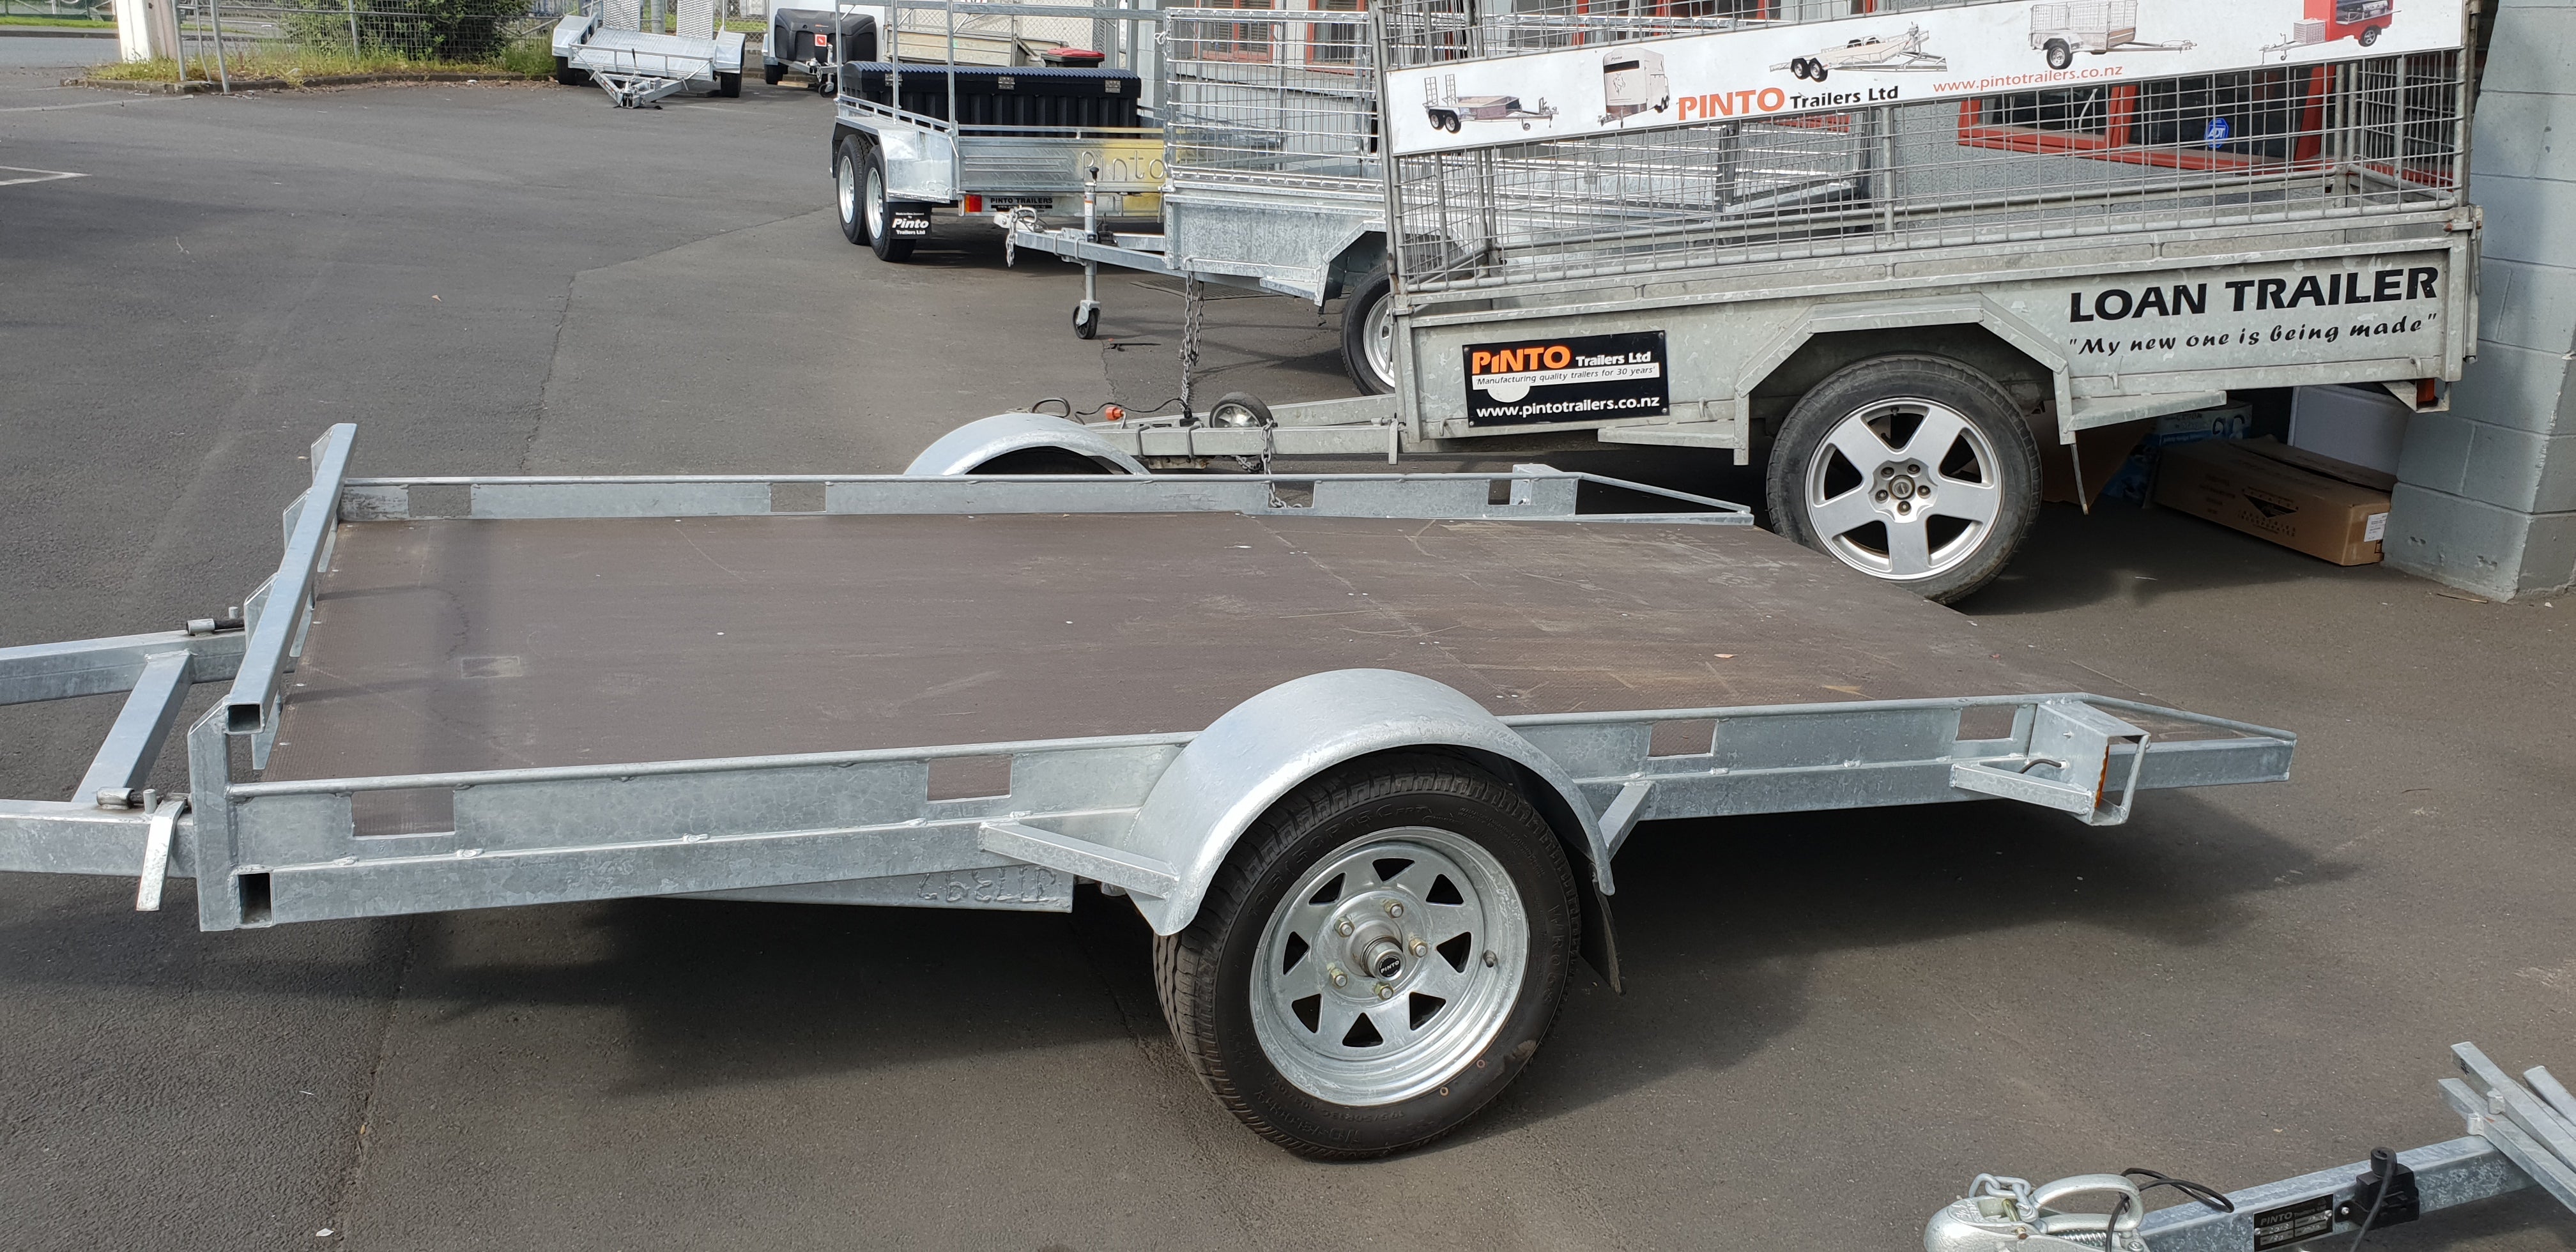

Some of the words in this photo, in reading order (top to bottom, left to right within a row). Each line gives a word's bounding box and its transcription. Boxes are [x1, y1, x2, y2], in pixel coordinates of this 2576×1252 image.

[1933, 66, 2123, 92] www.pintotrailers.co.nz
[1678, 88, 1785, 120] PINTO
[1790, 93, 1860, 109] Trailers
[1868, 86, 1899, 101] Ltd
[1082, 150, 1165, 181] Pinto
[892, 218, 929, 229] Pinto
[2070, 283, 2207, 323] LOAN
[2225, 267, 2439, 312] TRAILER
[2069, 338, 2120, 356] "My
[2130, 337, 2176, 351] new
[2186, 333, 2229, 347] one
[2239, 328, 2260, 345] is
[2270, 323, 2339, 343] being
[2349, 312, 2437, 337] made"
[1575, 353, 1624, 367] Trailers
[1628, 351, 1652, 363] Ltd
[1539, 371, 1568, 382] quality
[1571, 369, 1599, 379] trailers
[1601, 368, 1614, 377] for
[1616, 367, 1628, 376] 30
[1476, 397, 1660, 418] www.pintotrailers.co.nz
[1381, 960, 1400, 973] PINTO
[2260, 1212, 2293, 1226] PINTO
